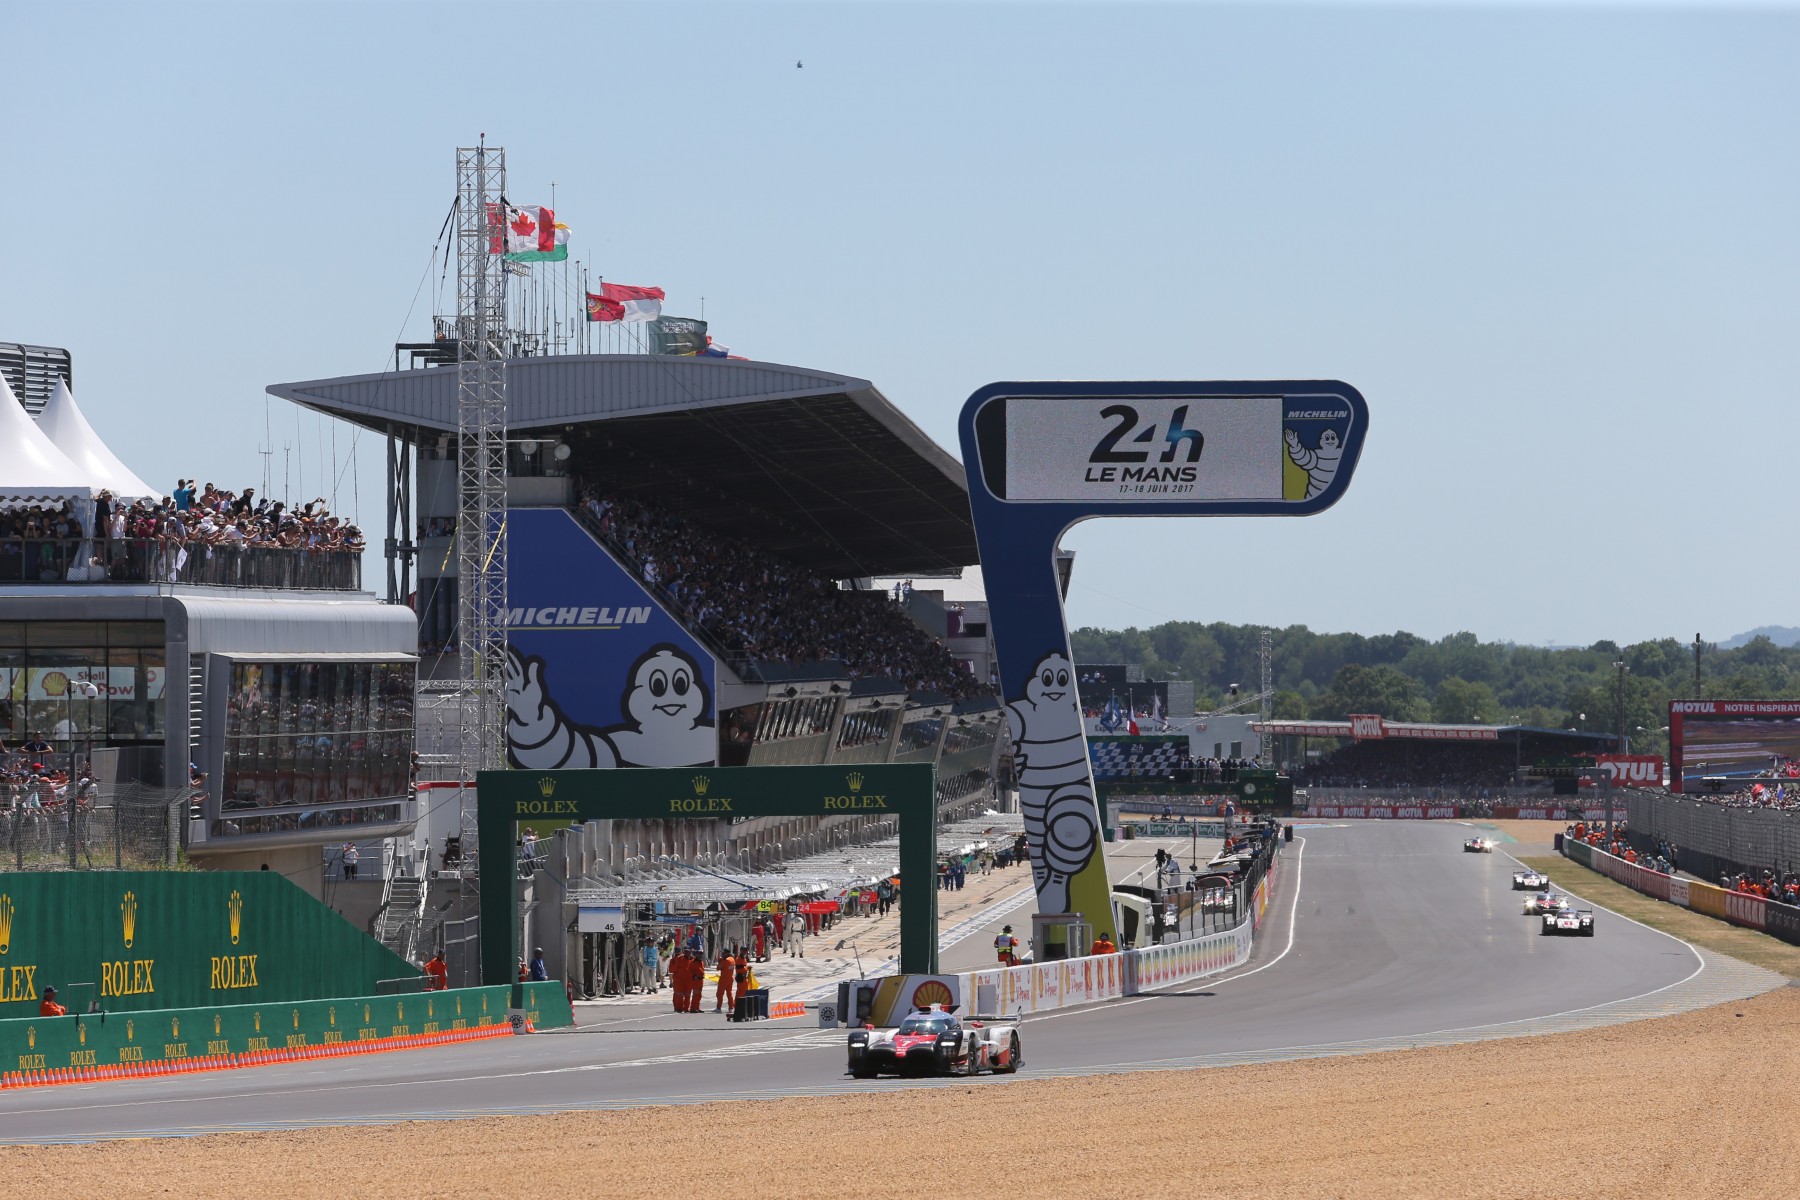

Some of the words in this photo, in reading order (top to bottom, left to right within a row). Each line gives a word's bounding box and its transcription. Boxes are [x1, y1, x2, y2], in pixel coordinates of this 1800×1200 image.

[1287, 410, 1348, 418] MICHELIN
[1089, 404, 1205, 463] 24h
[1085, 467, 1117, 482] LE
[1121, 467, 1197, 482] MANS
[1147, 484, 1168, 493] JUIN
[1171, 484, 1194, 493] 2017
[494, 606, 652, 625] MICHELIN
[1672, 702, 1716, 713] MOTUL
[1724, 704, 1756, 712] NOTRE
[1353, 718, 1382, 736] MOTUL
[1579, 762, 1659, 781] OTUL
[515, 800, 580, 814] ROLEX
[669, 798, 733, 812] ROLEX
[823, 795, 888, 809] ROLEX
[1342, 807, 1366, 817] MOTUL
[1369, 807, 1393, 818] MOTUL
[1398, 807, 1424, 818] MOTUL
[1427, 807, 1455, 818] MOTUL
[1518, 809, 1548, 819] MOTUL
[760, 901, 771, 909] 84
[604, 923, 615, 931] 45
[100, 959, 155, 997] ROLEX
[210, 954, 258, 990] ROLEX
[164, 1043, 188, 1058] ROLEX
[207, 1039, 229, 1054] ROLEX
[248, 1037, 269, 1051] ROLEX
[70, 1050, 97, 1066] ROLEX
[119, 1046, 143, 1062] ROLEX
[19, 1054, 46, 1070] ROLEX
